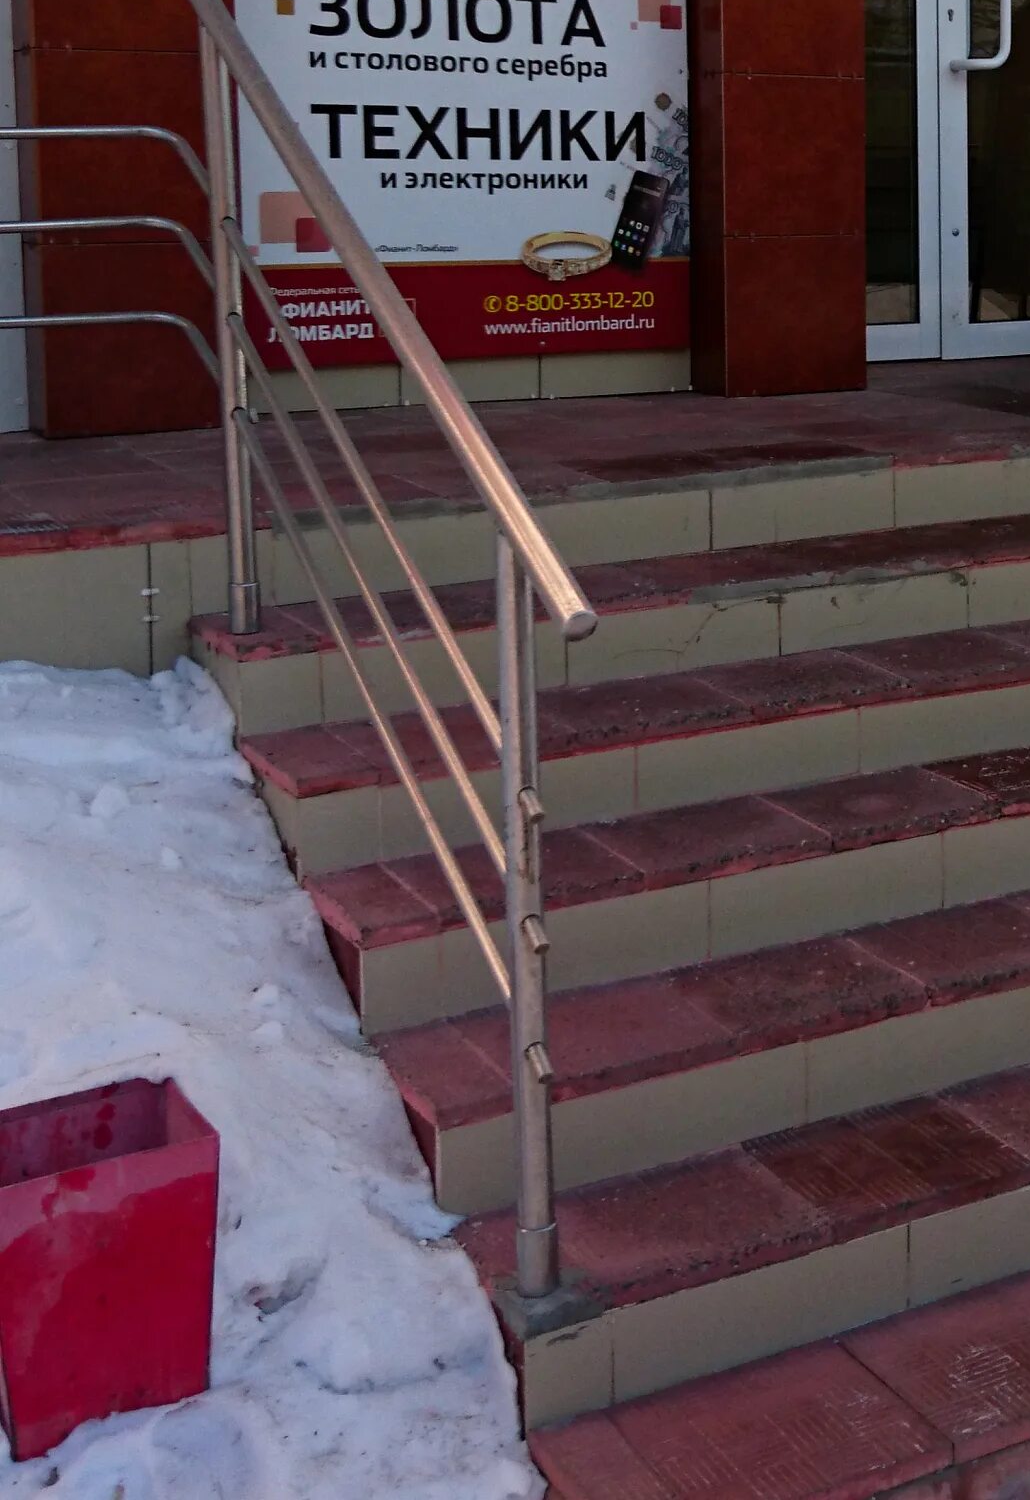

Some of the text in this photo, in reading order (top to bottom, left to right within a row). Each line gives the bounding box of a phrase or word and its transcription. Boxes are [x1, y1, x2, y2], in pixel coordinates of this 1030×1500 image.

[309, 51, 608, 83] и столового серебра
[310, 103, 646, 162] ТЕХНИКИ
[381, 172, 588, 195] и электроники
[506, 291, 654, 312] 8-800-333-12-20
[484, 313, 655, 335] www.fianitlombard.ru
